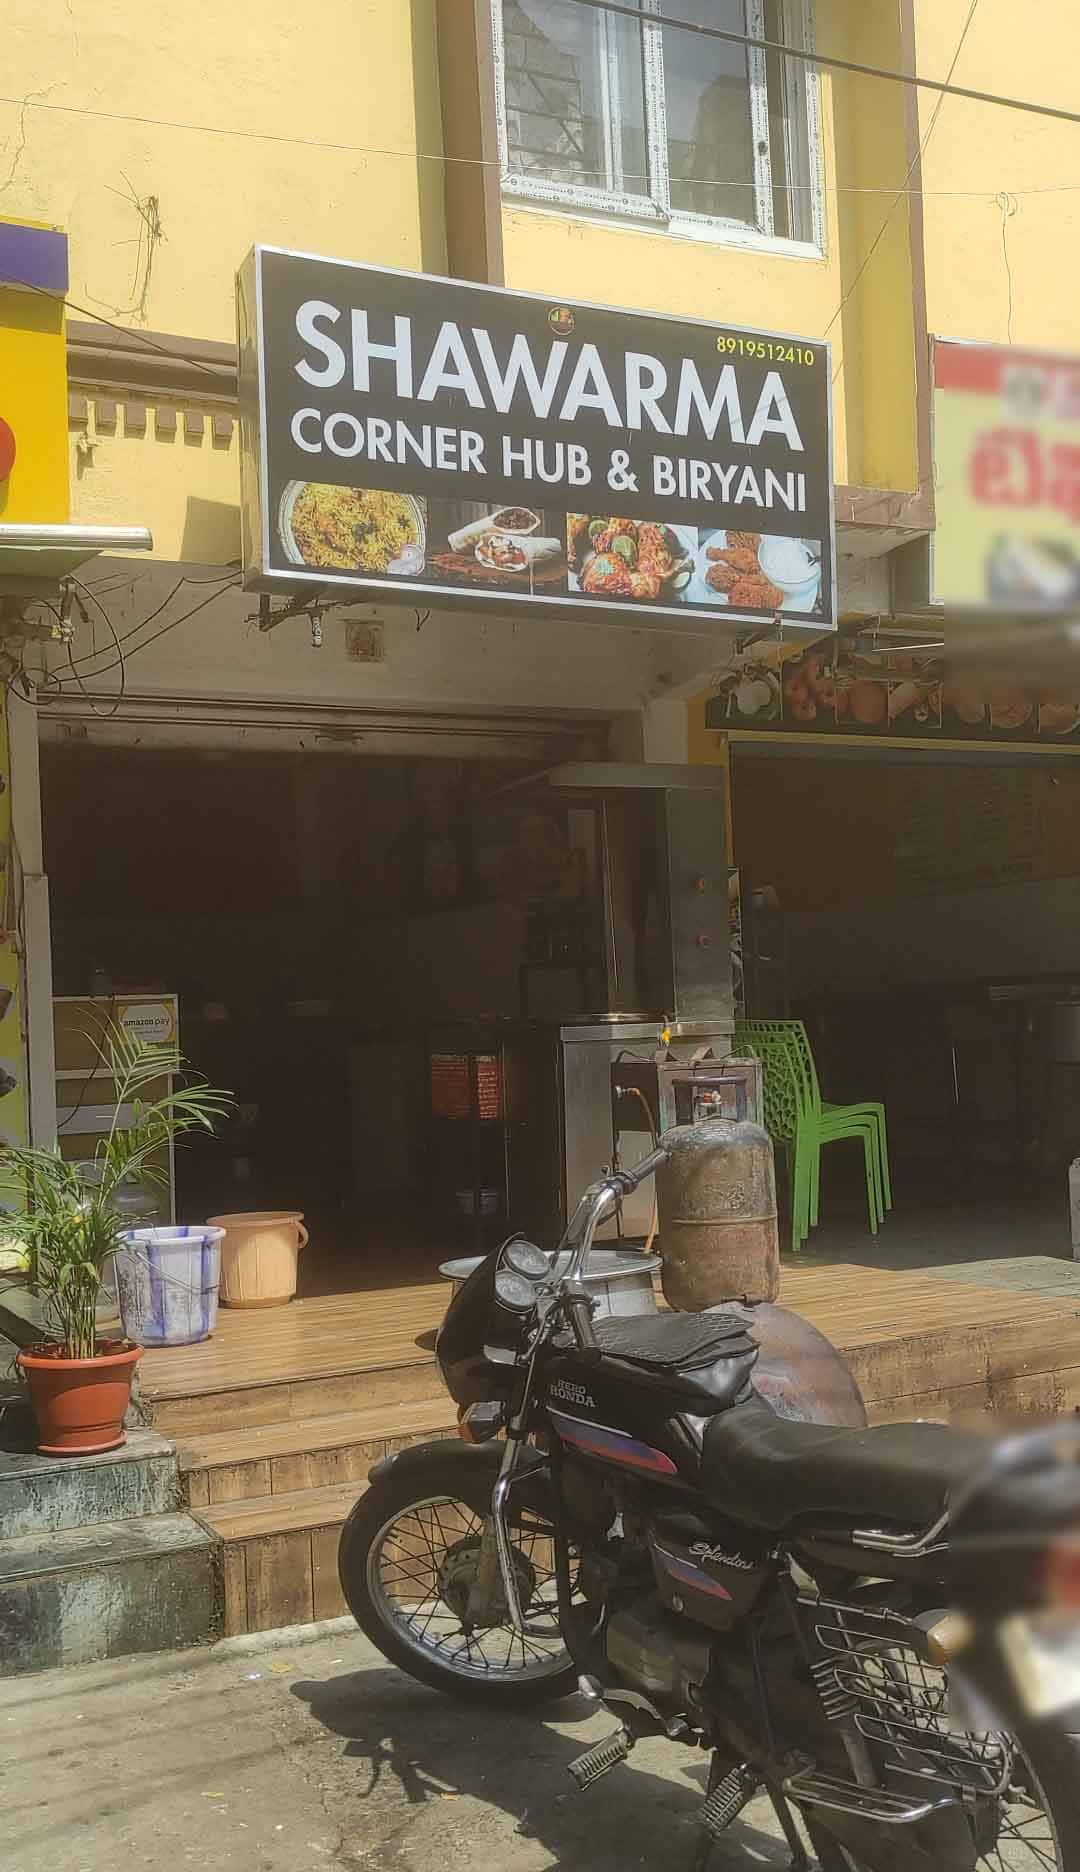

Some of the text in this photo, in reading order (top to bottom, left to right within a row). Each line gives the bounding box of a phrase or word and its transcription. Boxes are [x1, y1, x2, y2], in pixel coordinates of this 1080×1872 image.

[716, 335, 815, 366] 8919512410
[294, 300, 805, 452] SHAWARMA
[290, 407, 807, 512] CORNER HUB & BIRYANI
[550, 1384, 597, 1408] HONDA
[558, 1380, 586, 1395] HERO
